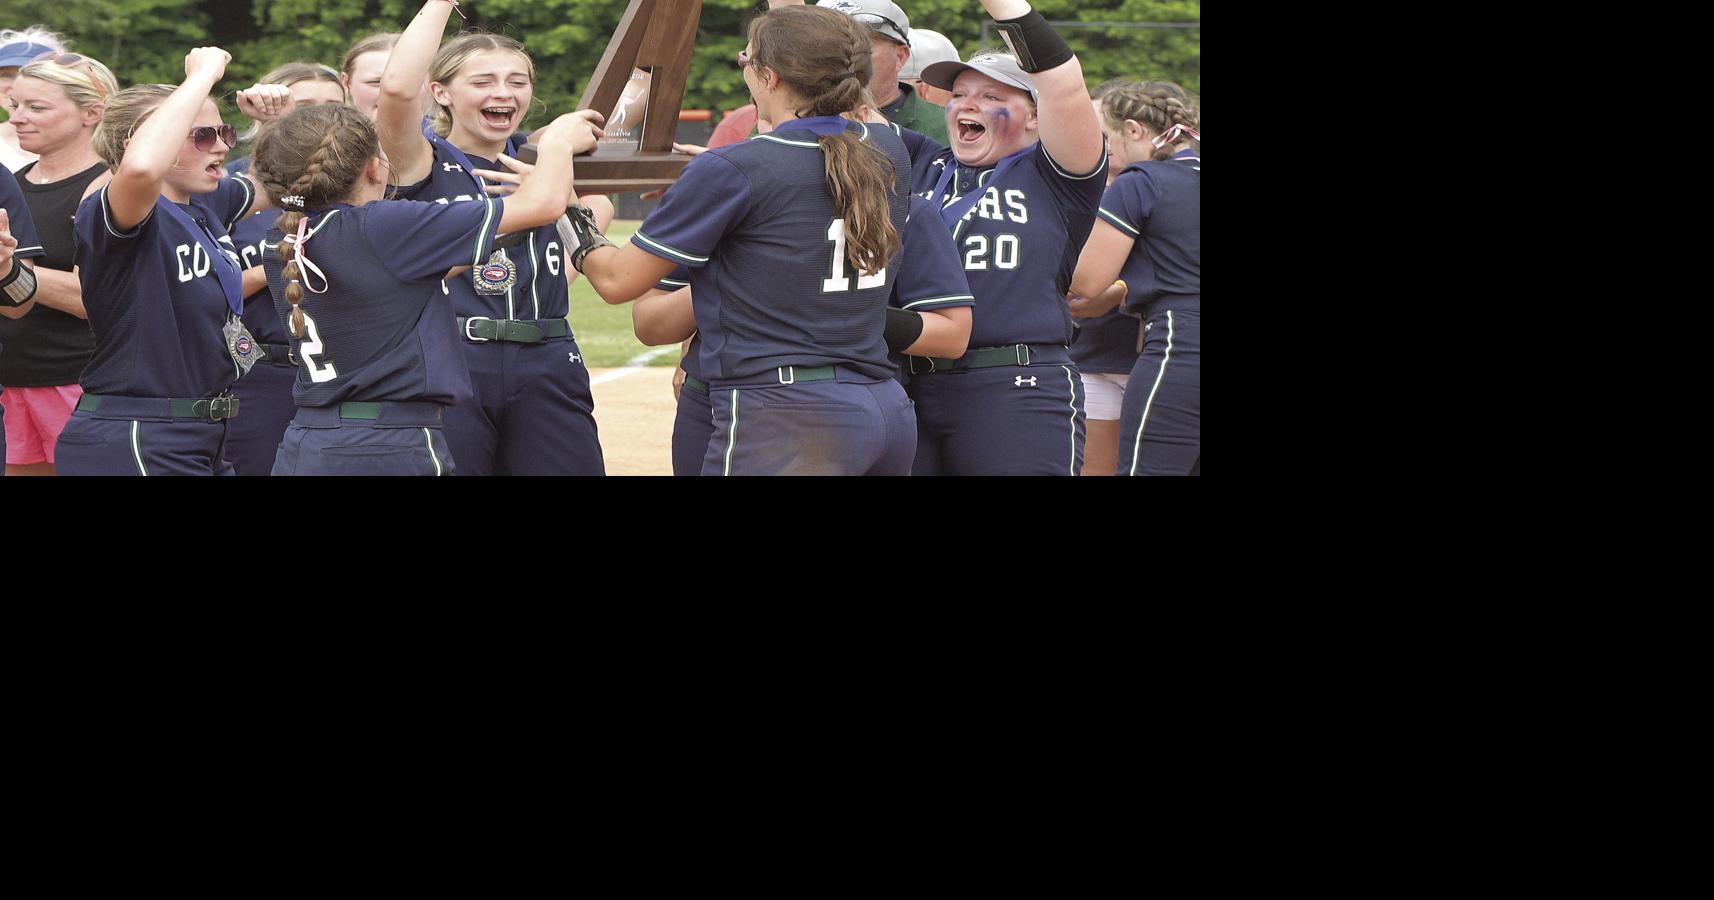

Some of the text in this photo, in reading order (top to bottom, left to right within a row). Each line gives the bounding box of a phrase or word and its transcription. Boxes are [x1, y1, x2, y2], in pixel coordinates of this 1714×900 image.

[545, 241, 560, 275] 6
[964, 234, 1019, 270] 20
[288, 312, 337, 383] 2
